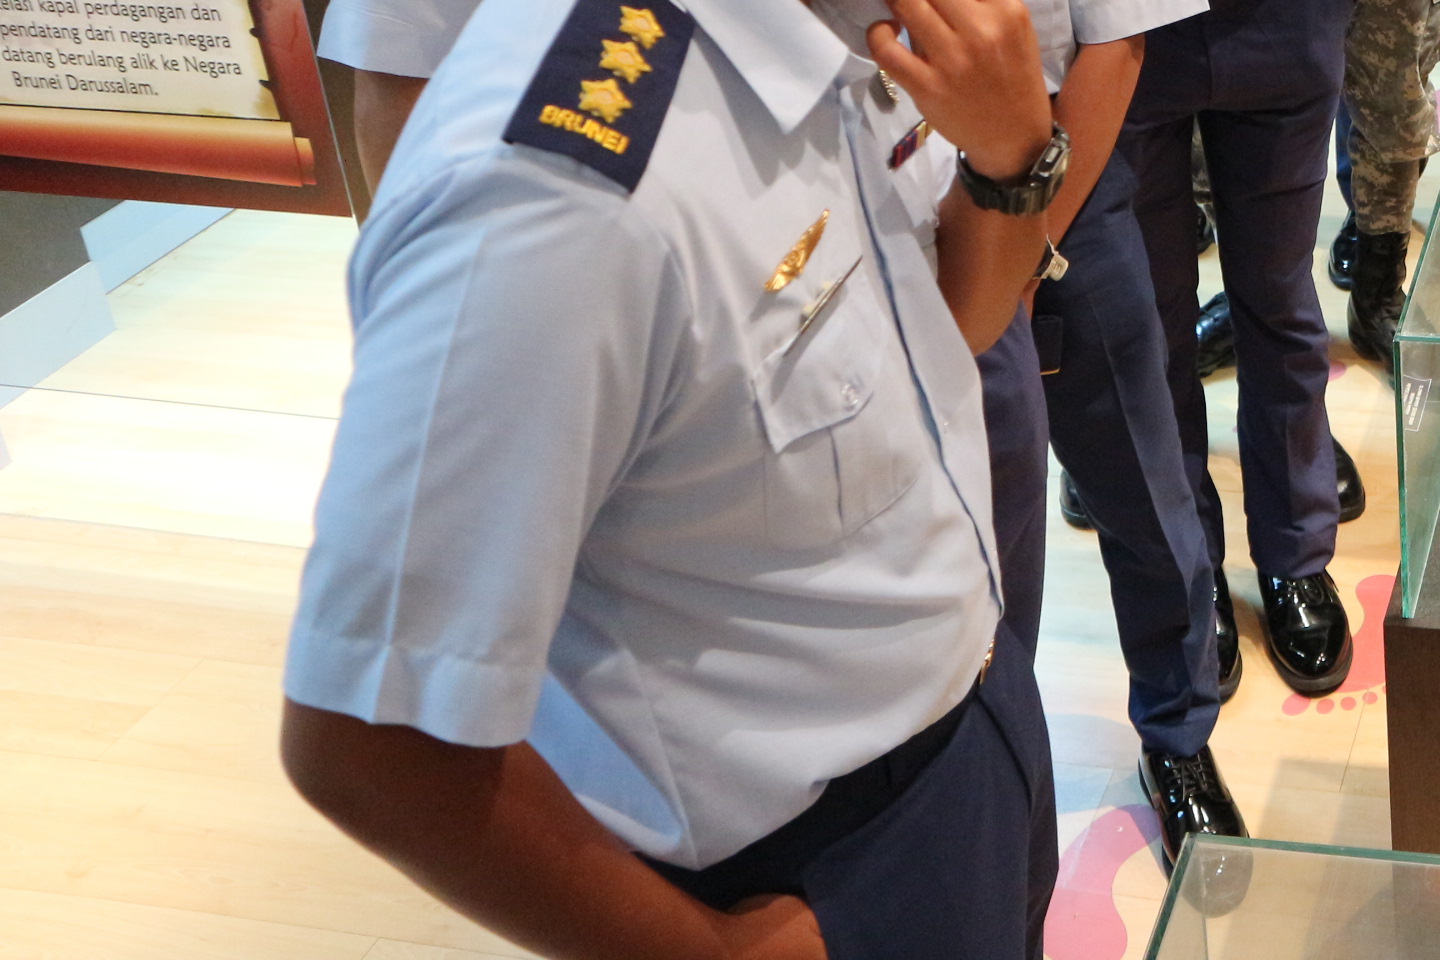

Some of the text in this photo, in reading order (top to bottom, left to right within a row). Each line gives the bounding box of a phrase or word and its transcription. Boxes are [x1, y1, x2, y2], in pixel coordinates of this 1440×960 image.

[84, 0, 186, 23] perdagangan
[191, 3, 222, 22] dan
[0, 21, 231, 52] pendatang dari negara-negara
[2, 45, 243, 78] datang berulang alik ke Negara
[11, 70, 159, 97] Brunei Darussalam.
[538, 104, 630, 155] BRUNEI
